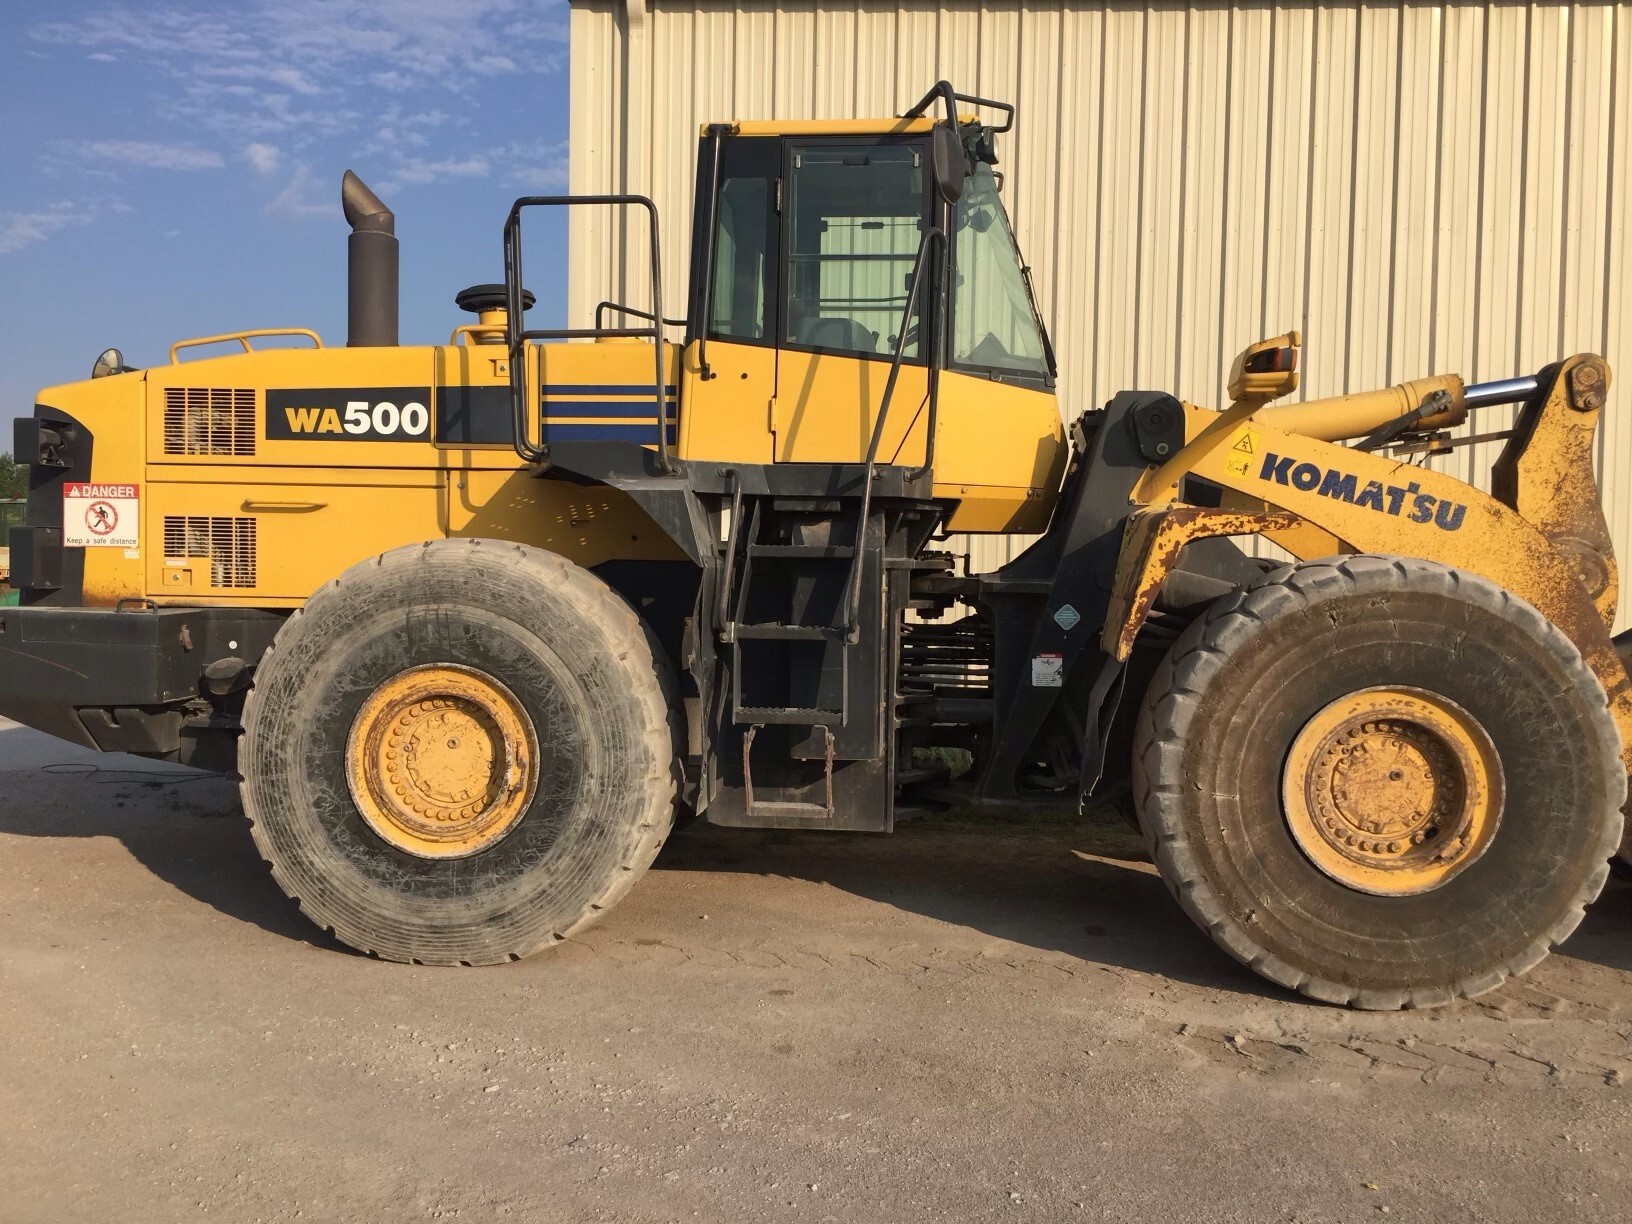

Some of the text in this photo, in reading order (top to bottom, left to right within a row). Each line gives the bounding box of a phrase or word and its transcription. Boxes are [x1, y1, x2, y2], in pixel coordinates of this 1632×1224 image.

[285, 401, 429, 436] WA500
[82, 485, 135, 497] DANGER
[1259, 452, 1467, 531] KOMATSU
[66, 537, 83, 545] Keep
